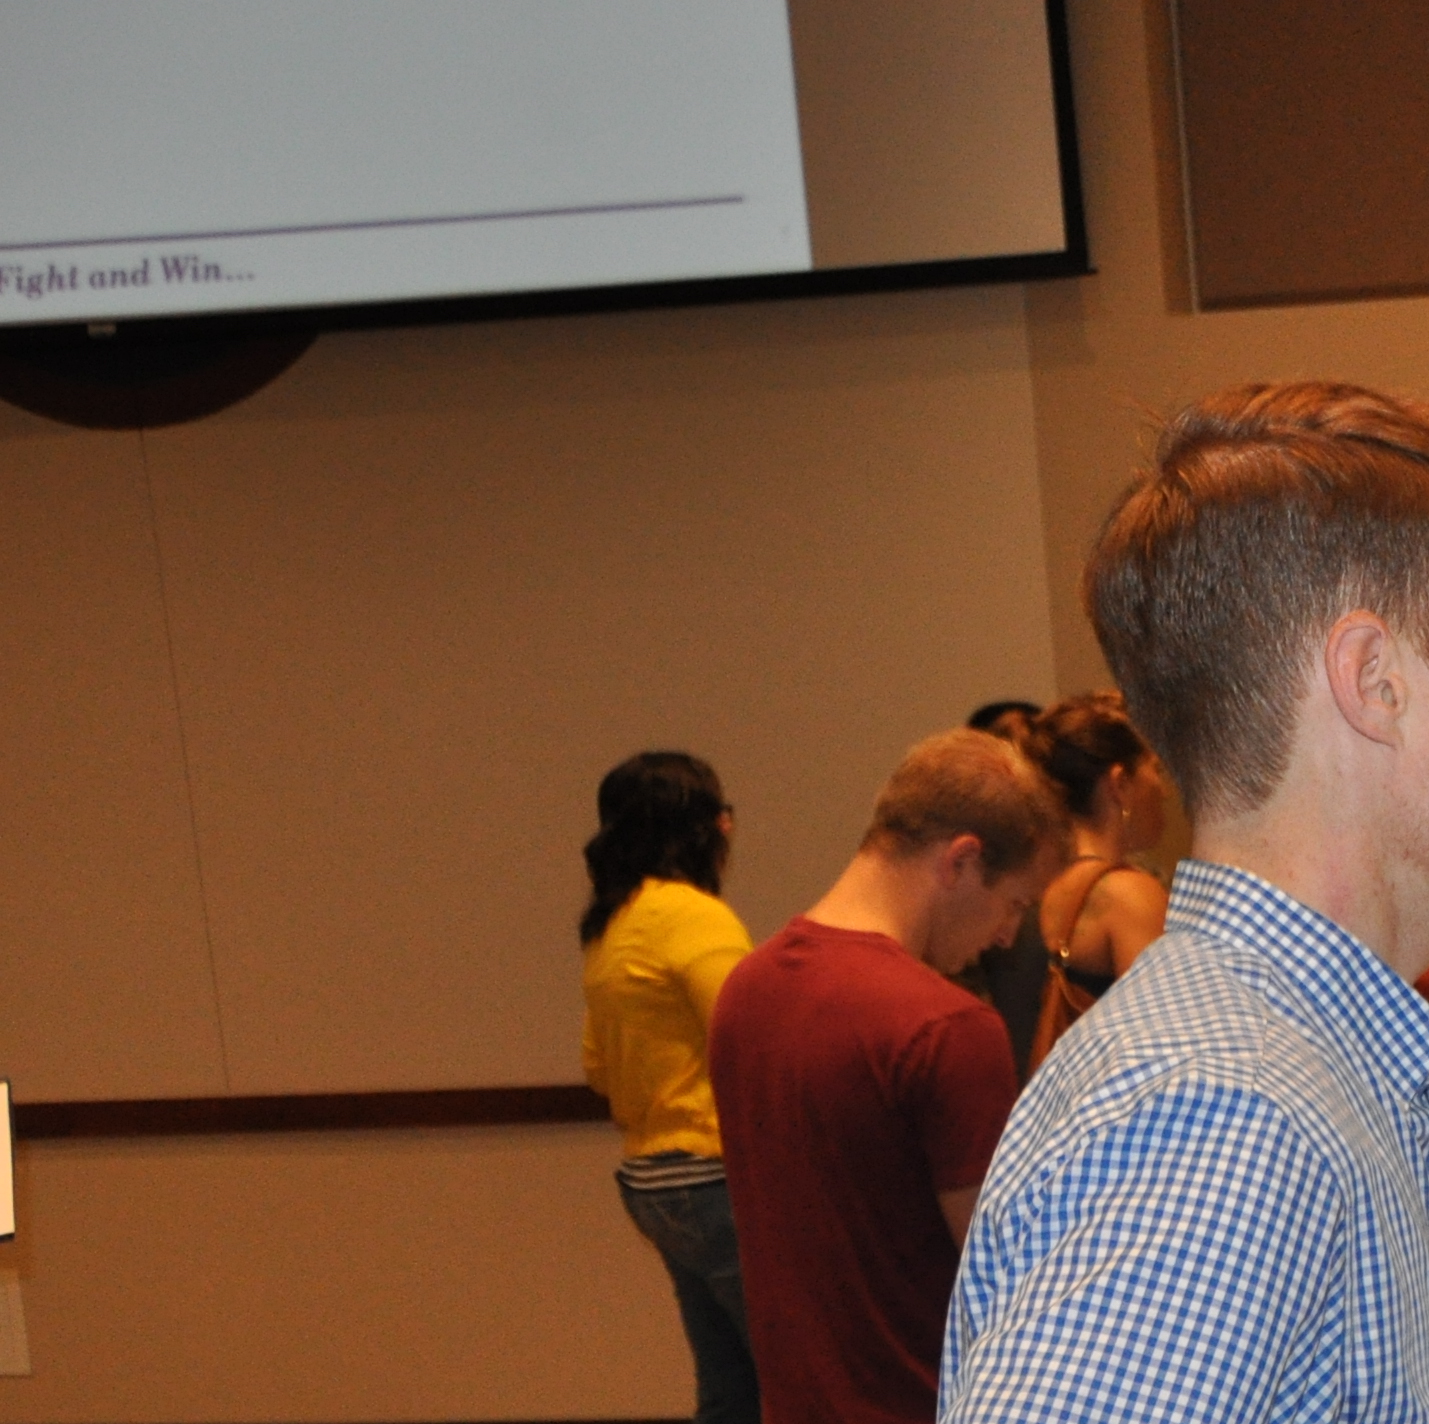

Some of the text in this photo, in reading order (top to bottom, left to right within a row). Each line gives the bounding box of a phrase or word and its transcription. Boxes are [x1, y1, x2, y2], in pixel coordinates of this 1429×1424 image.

[0, 254, 256, 300] Fight and Win...
